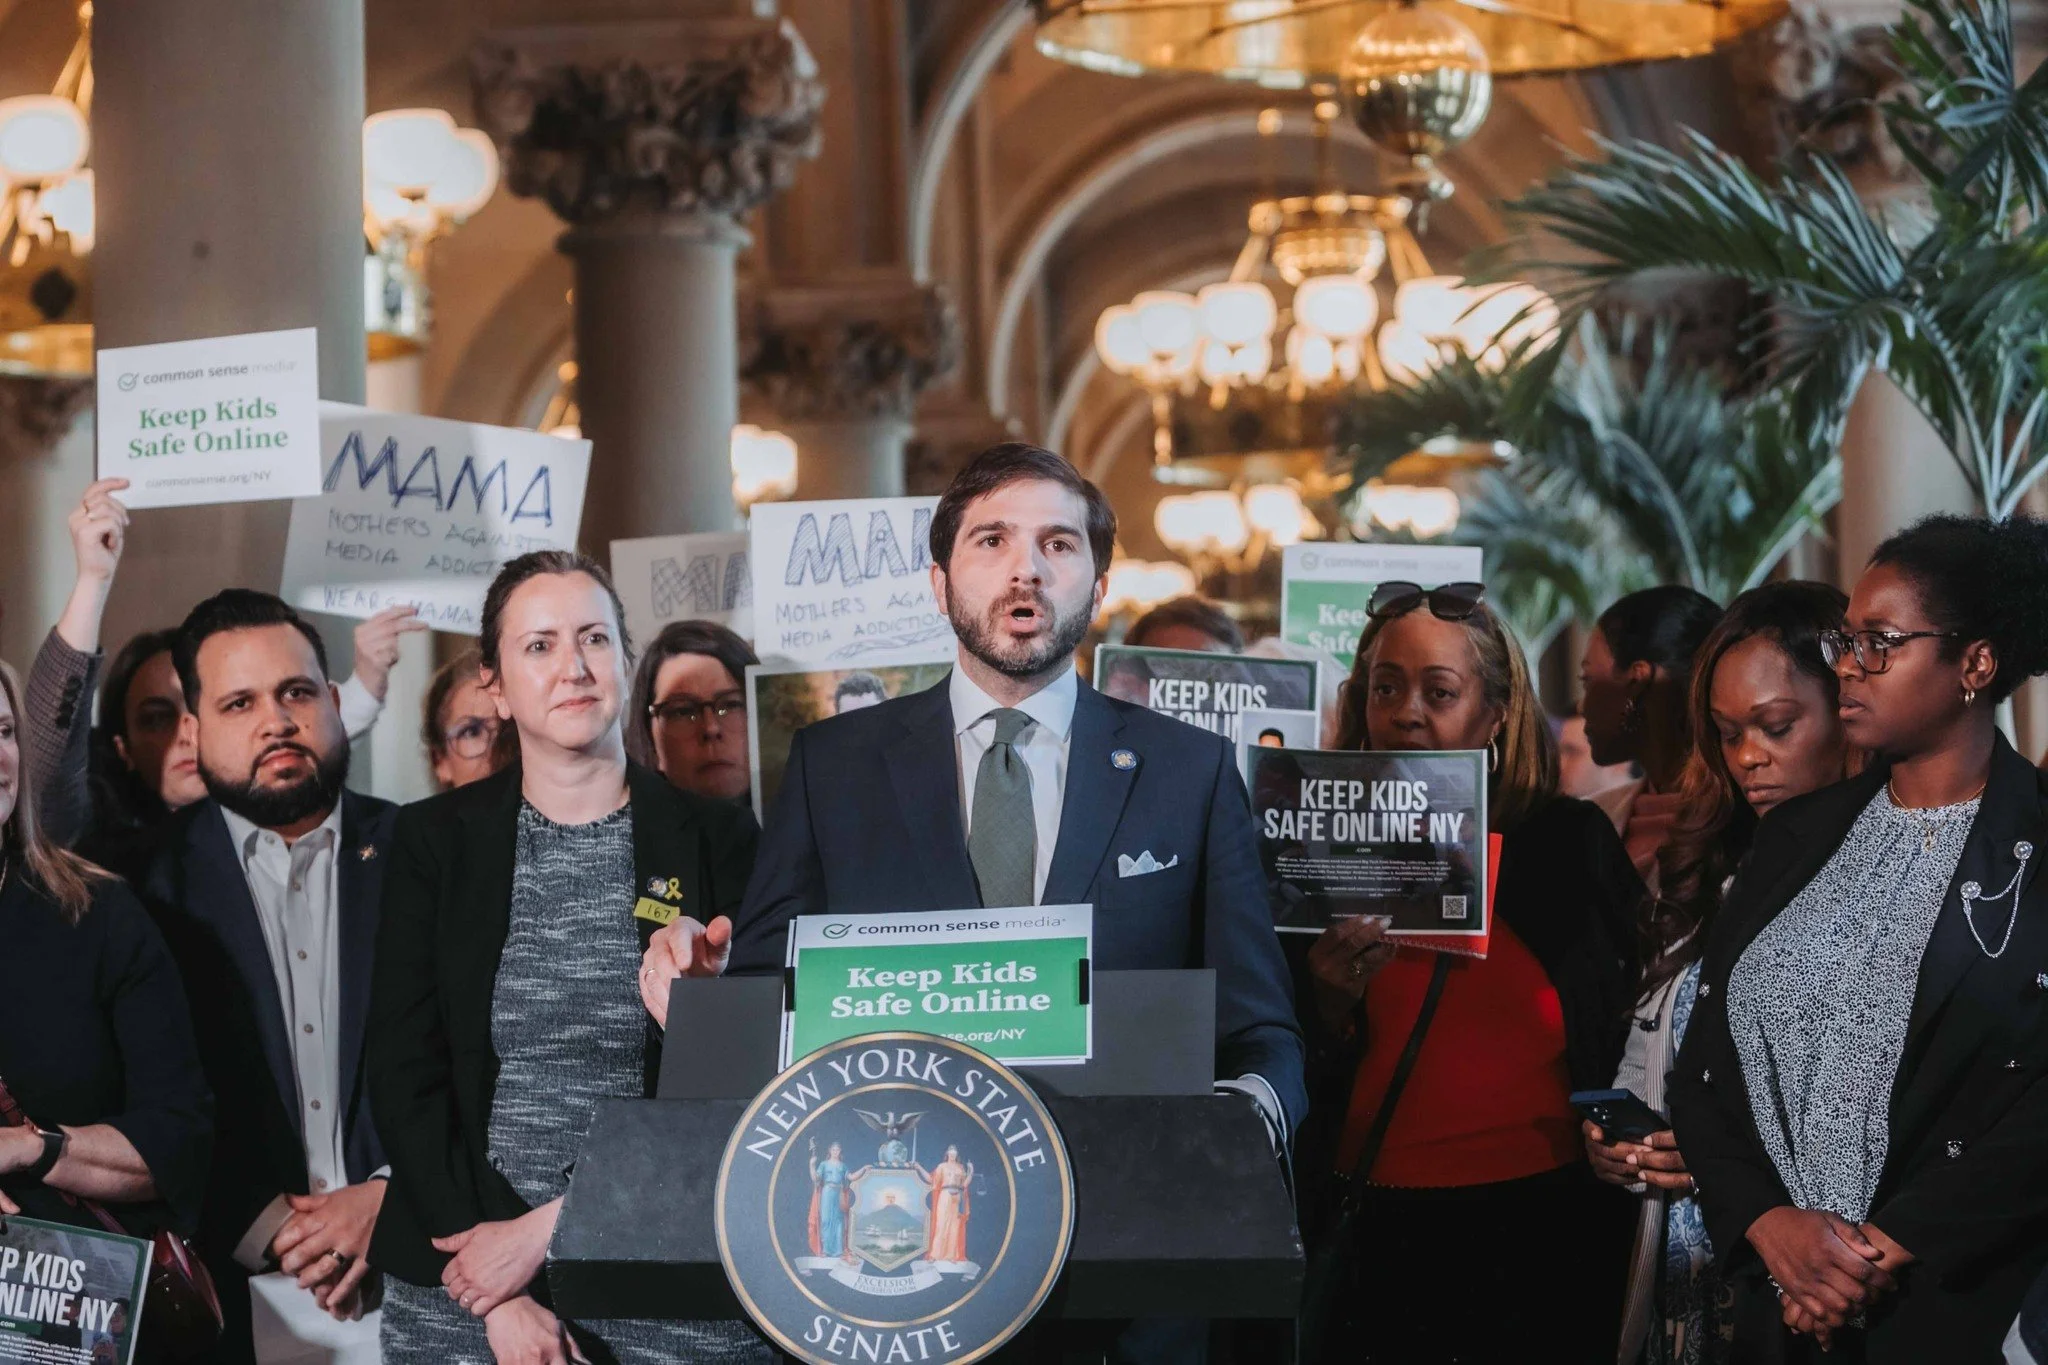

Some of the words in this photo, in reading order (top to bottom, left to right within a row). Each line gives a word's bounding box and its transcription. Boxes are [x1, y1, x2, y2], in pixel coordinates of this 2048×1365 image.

[143, 368, 204, 385] common
[208, 363, 248, 378] sense
[139, 406, 207, 430] Keep
[215, 397, 277, 421] Kids
[128, 433, 186, 460] Safe
[194, 427, 289, 453] Online
[322, 430, 552, 527] MAMA
[785, 507, 931, 587] MA
[775, 597, 865, 625] MOTHERS
[1317, 603, 1368, 627] Kee
[781, 629, 831, 650] MEDIA
[1148, 678, 1210, 711] KEEP
[1213, 681, 1267, 713] KIDS
[1300, 778, 1364, 811] KEEP
[1370, 779, 1429, 813] KIDS
[1264, 808, 1326, 841] SAFE
[1332, 811, 1423, 844] ONLINE
[1429, 812, 1465, 843] NY
[647, 904, 671, 920] 167
[857, 922, 940, 936] common
[946, 919, 1000, 932] sense
[1005, 916, 1061, 930] media
[847, 967, 943, 992] Keep
[951, 961, 1037, 985] Kids
[831, 992, 912, 1018] Safe
[921, 989, 1050, 1015] Online
[745, 1071, 823, 1162] NEW
[828, 1048, 953, 1086] YORK
[955, 1068, 1047, 1172] STATE
[22, 1251, 86, 1293] KIDS
[857, 1276, 915, 1287] EXCELSIOR
[0, 1281, 76, 1327] NLINE
[77, 1296, 119, 1334] NY
[804, 1314, 961, 1365] SENATE
